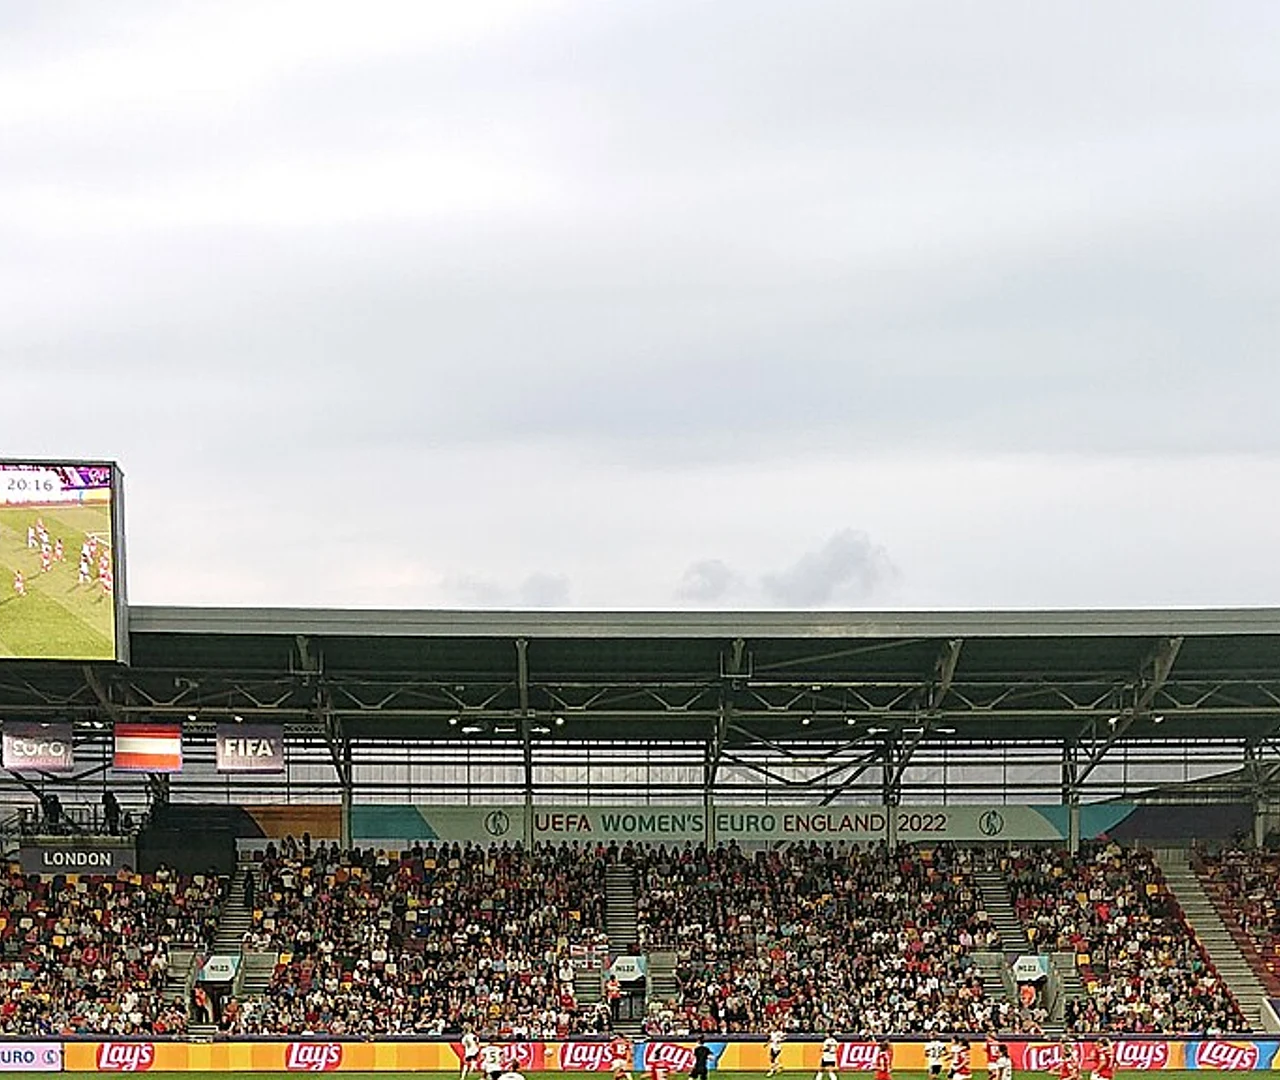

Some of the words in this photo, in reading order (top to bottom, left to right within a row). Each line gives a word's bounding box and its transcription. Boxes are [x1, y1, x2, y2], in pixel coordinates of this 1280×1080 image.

[6, 477, 54, 491] 20:16
[225, 738, 274, 757] FIFA
[535, 814, 592, 832] UEFA
[601, 814, 704, 832] WOMEN'S
[717, 814, 776, 832] EURO
[783, 814, 885, 832] ENGLAND
[898, 813, 947, 832] 2022
[43, 852, 112, 866] LONDON
[99, 1042, 152, 1072] Lay's
[288, 1042, 340, 1070] Lay's
